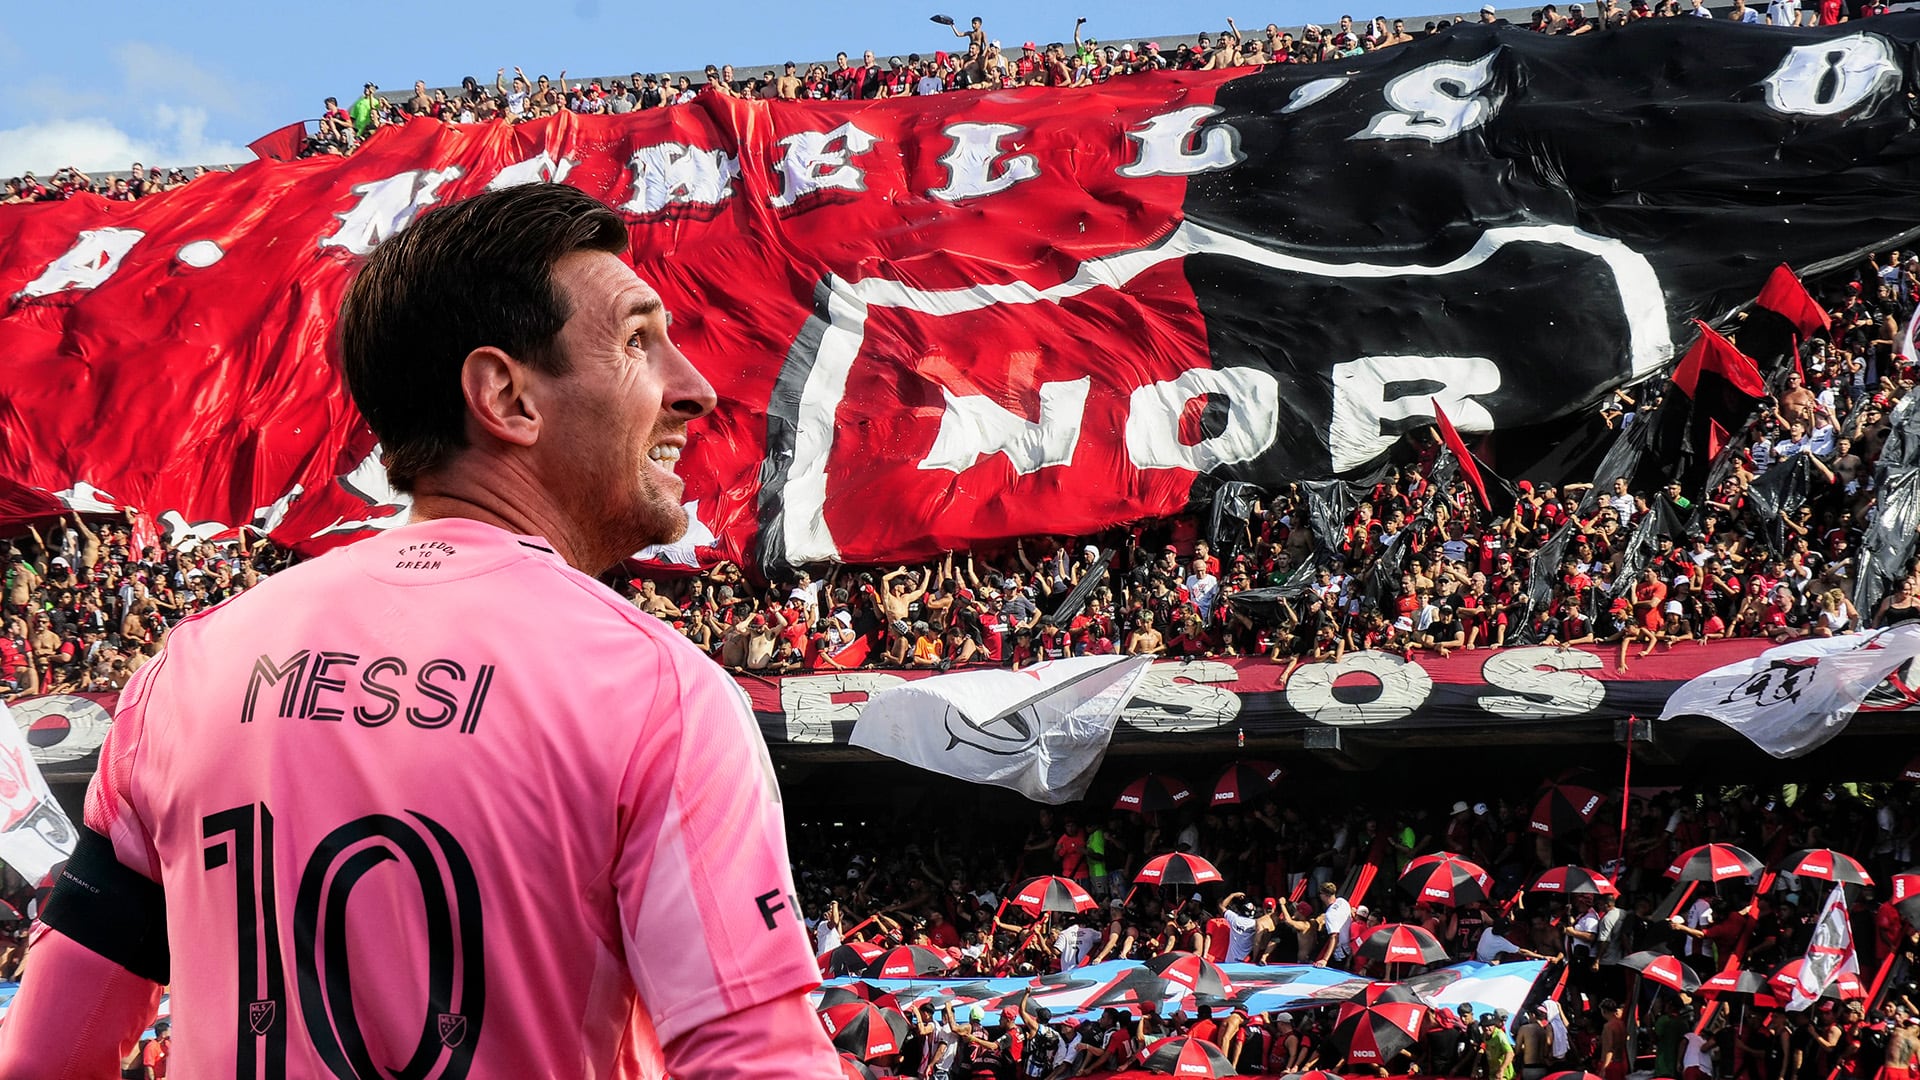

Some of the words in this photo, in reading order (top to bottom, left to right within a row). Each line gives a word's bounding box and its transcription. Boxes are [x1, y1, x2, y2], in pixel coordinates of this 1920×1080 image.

[419, 550, 432, 558] TO
[395, 561, 441, 570] DREAM
[241, 649, 495, 734] MESSI
[1268, 768, 1281, 782] NOB
[1121, 795, 1139, 804] NOB
[1172, 790, 1190, 801] NOB
[1216, 792, 1234, 800] NOB
[1580, 795, 1599, 815] NOB
[1531, 821, 1549, 832] NOB
[1425, 887, 1450, 898] NOB
[1020, 894, 1040, 904] NOB
[203, 802, 485, 1080] 10
[1392, 946, 1417, 955] NOB
[885, 966, 909, 975] NOB
[1169, 968, 1193, 983] NOB
[252, 1004, 266, 1012] MLS
[441, 1017, 456, 1025] MLS
[822, 1012, 837, 1034] NOB
[1407, 1008, 1420, 1033] NOB
[870, 1043, 892, 1055] NOB
[1353, 1050, 1376, 1058] NOB
[1181, 1063, 1207, 1073] NOB
